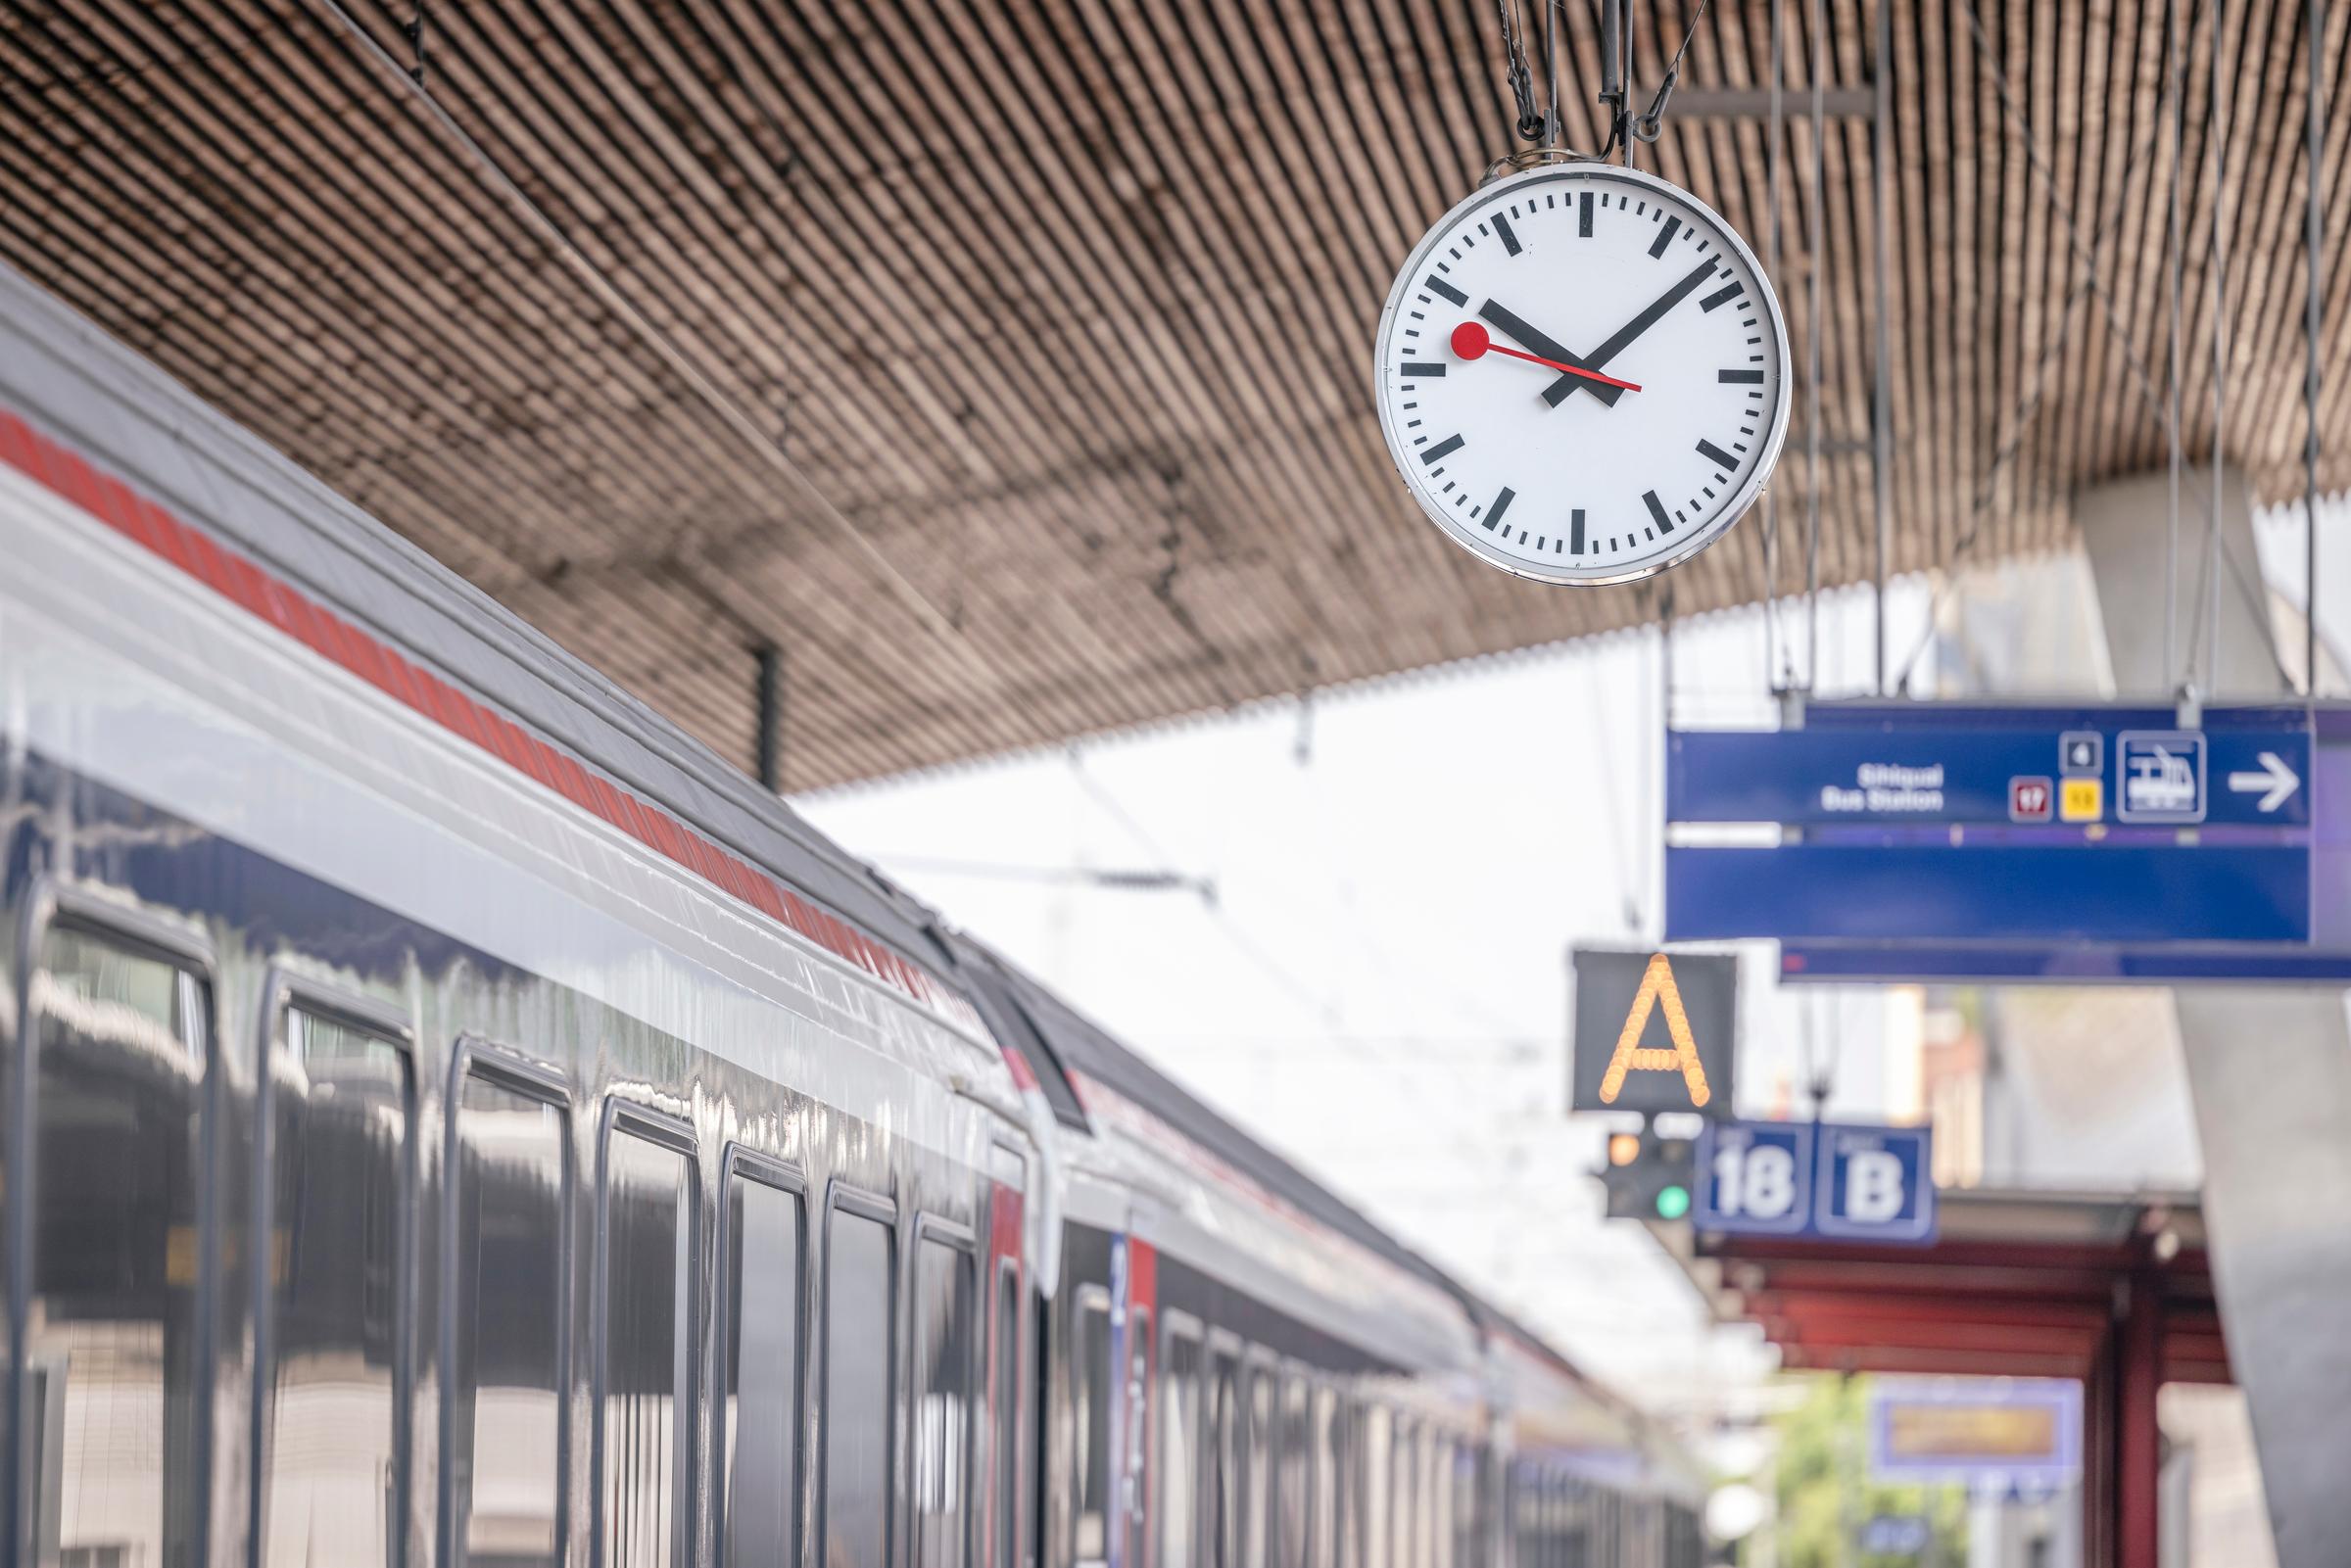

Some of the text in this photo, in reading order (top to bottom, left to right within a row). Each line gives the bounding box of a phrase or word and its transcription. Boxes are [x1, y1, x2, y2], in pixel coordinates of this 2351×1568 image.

[1821, 785, 1943, 811] Bus Station
[1600, 953, 1710, 1107] A
[1714, 1144, 1795, 1218] 18
[1846, 1150, 1903, 1222] B
